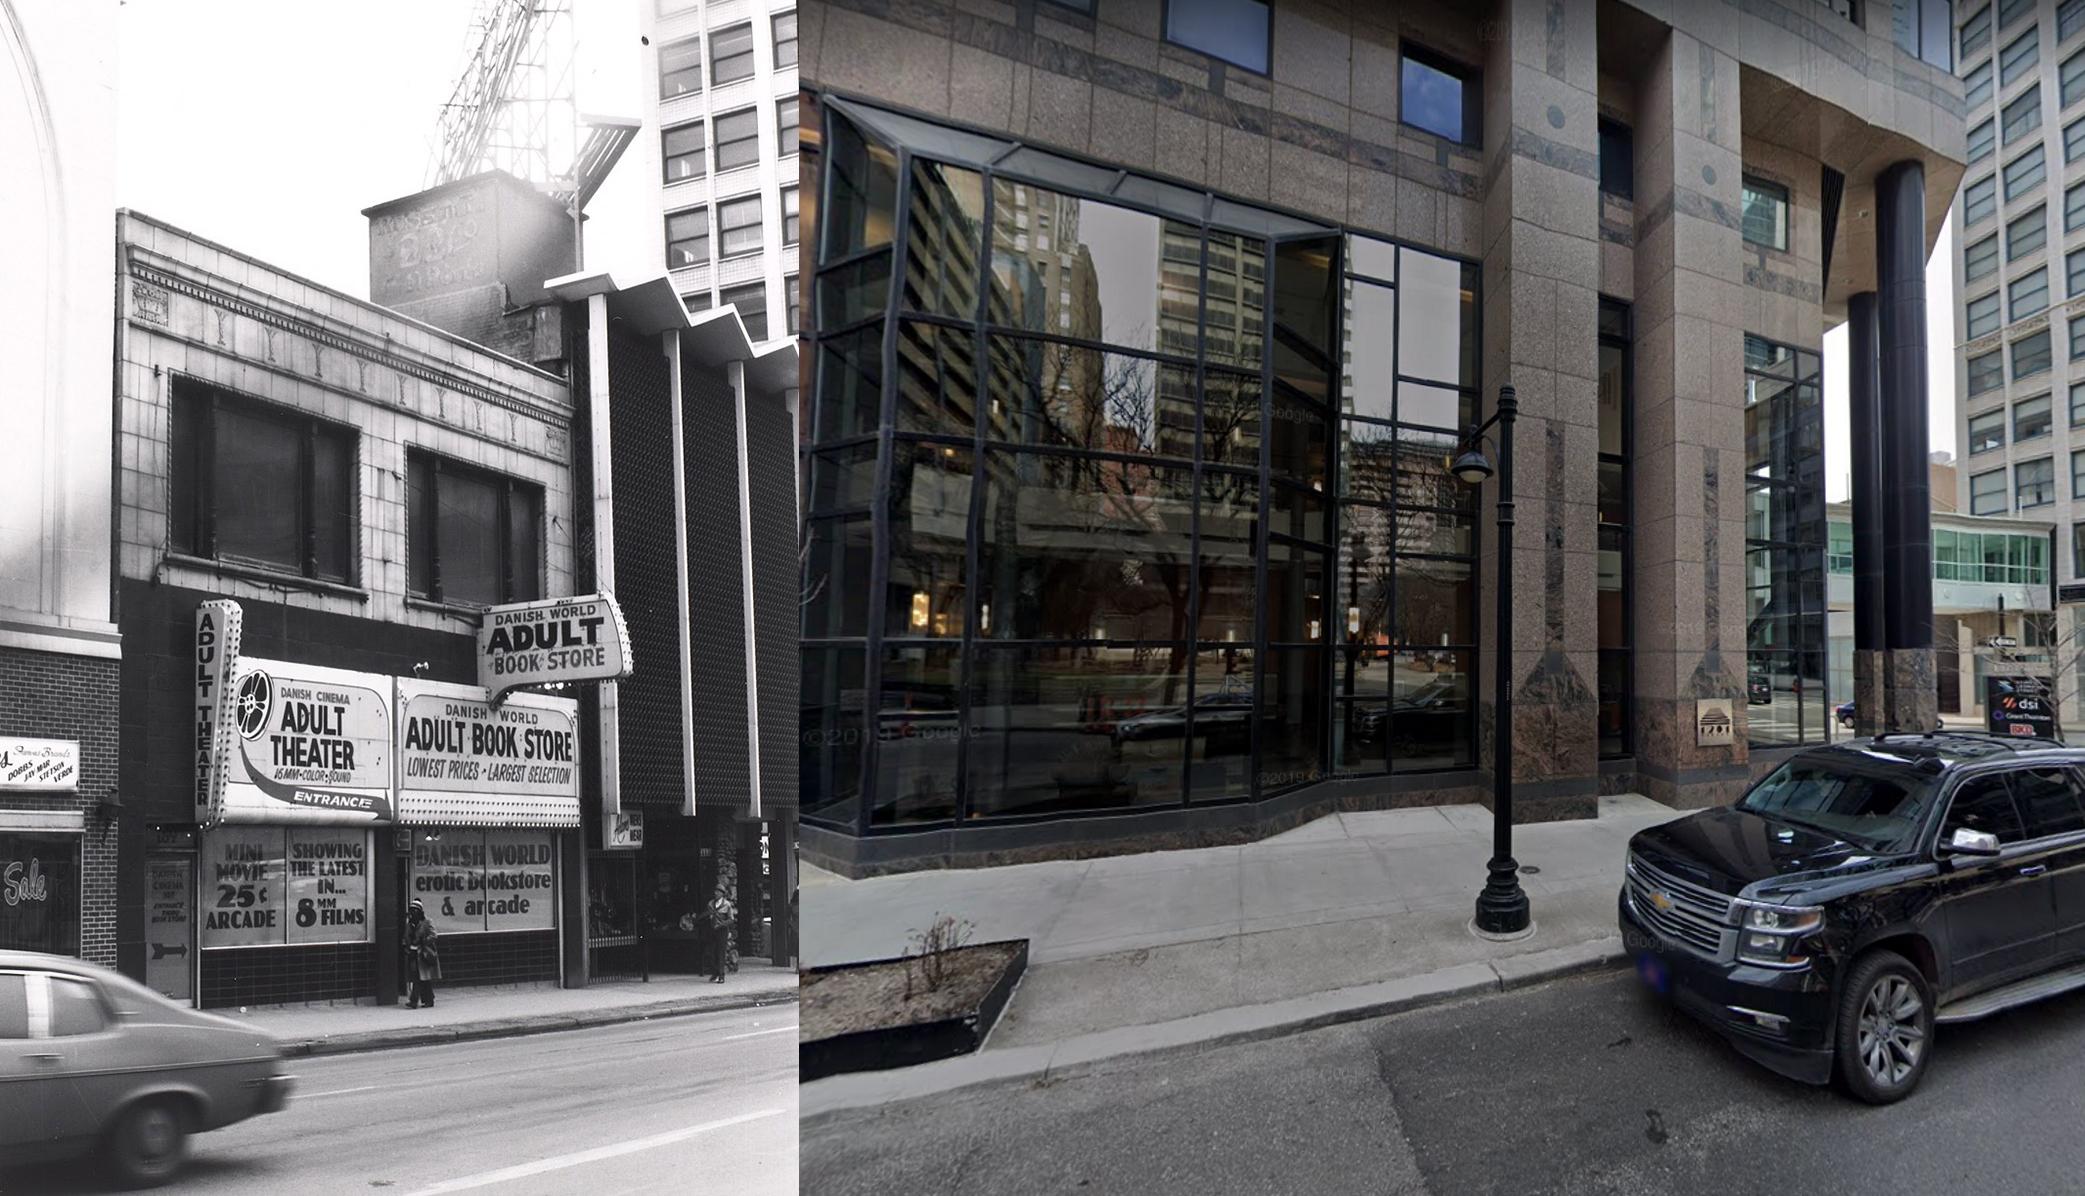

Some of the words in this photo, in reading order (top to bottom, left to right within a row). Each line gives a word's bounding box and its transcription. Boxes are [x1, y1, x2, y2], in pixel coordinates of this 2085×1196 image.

[495, 611, 544, 626] DANISH
[550, 604, 596, 619] WORLD
[487, 616, 605, 654] ADULT
[198, 613, 214, 698] ADULT
[494, 654, 540, 676] BOOK
[547, 648, 605, 670] STORE
[281, 687, 312, 701] DANISH
[316, 691, 350, 705] CINEMA
[2019, 698, 2038, 709] dsi
[280, 701, 345, 737] ADULT
[445, 704, 488, 720] DANISH
[499, 710, 539, 725] WORLD
[405, 717, 466, 754] ADULT
[472, 721, 519, 758] BOOK
[524, 728, 572, 762] STORE
[197, 706, 213, 806] THEATER
[270, 735, 355, 770] THEATER
[39, 762, 64, 782] STETSON
[407, 757, 446, 778] LOWEST
[448, 761, 479, 781] PRICES
[487, 765, 526, 784] LARGEST
[528, 766, 572, 785] SELECTION
[294, 791, 373, 809] ENTRANCE
[225, 843, 263, 862] MINI
[293, 842, 362, 859] SHOWING
[416, 844, 486, 867] DANISH
[491, 843, 551, 865] WORLD
[216, 862, 269, 882] MOVIE
[290, 861, 316, 877] THE
[319, 861, 364, 877] LATEST
[4, 858, 47, 906] Sale
[416, 873, 464, 892] erotic
[468, 871, 551, 892] bookstore
[295, 898, 316, 928] 8
[317, 898, 337, 908] MM
[441, 896, 455, 916] &
[464, 894, 530, 916] arcade
[205, 909, 276, 930] ARCADE
[321, 908, 364, 926] FILMS
